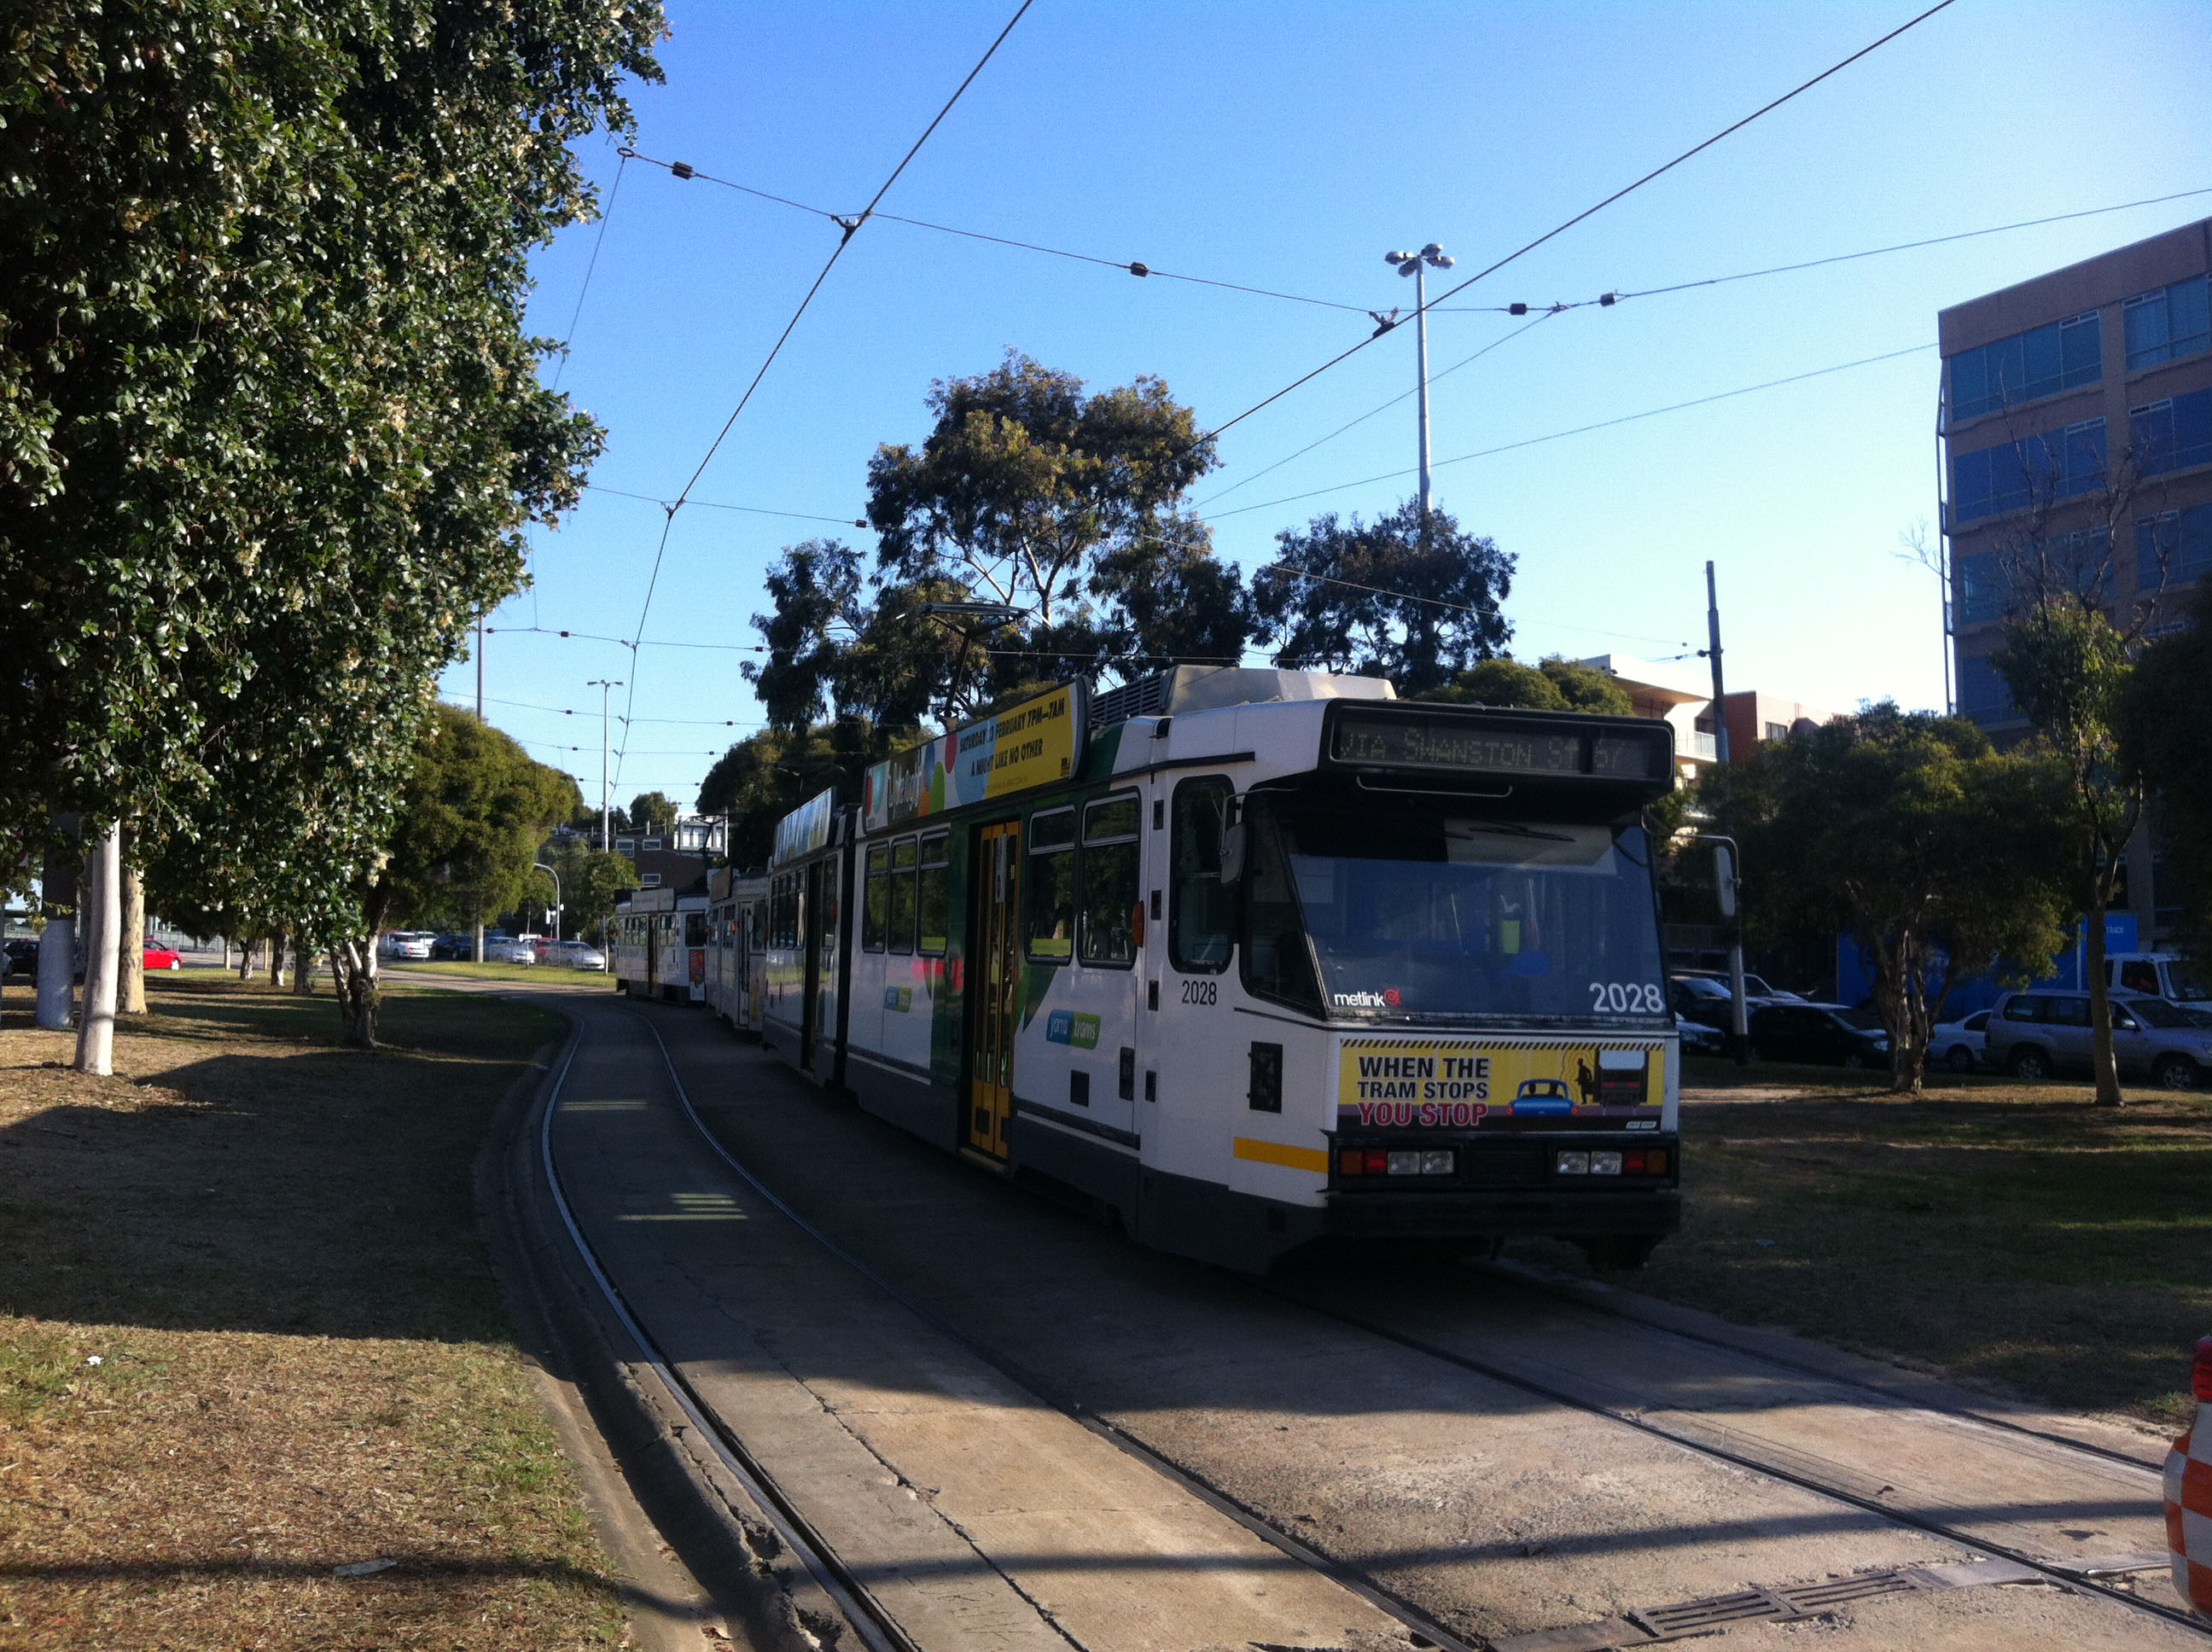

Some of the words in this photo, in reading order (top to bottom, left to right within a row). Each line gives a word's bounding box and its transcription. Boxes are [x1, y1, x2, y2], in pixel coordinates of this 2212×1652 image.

[994, 749, 1008, 770] LIKE
[1009, 746, 1019, 765] NO
[1021, 738, 1043, 761] OTHER
[1181, 980, 1218, 1005] 2028
[1334, 991, 1385, 1007] metlink
[1588, 982, 1665, 1014] 2028
[1073, 1019, 1097, 1040] trams
[1358, 1056, 1435, 1079] WHEN
[1442, 1057, 1490, 1079] THE
[1357, 1080, 1417, 1099] TRAM
[1423, 1081, 1489, 1100] STOPS
[1357, 1101, 1412, 1126] YOU
[1419, 1102, 1489, 1127] STOP
